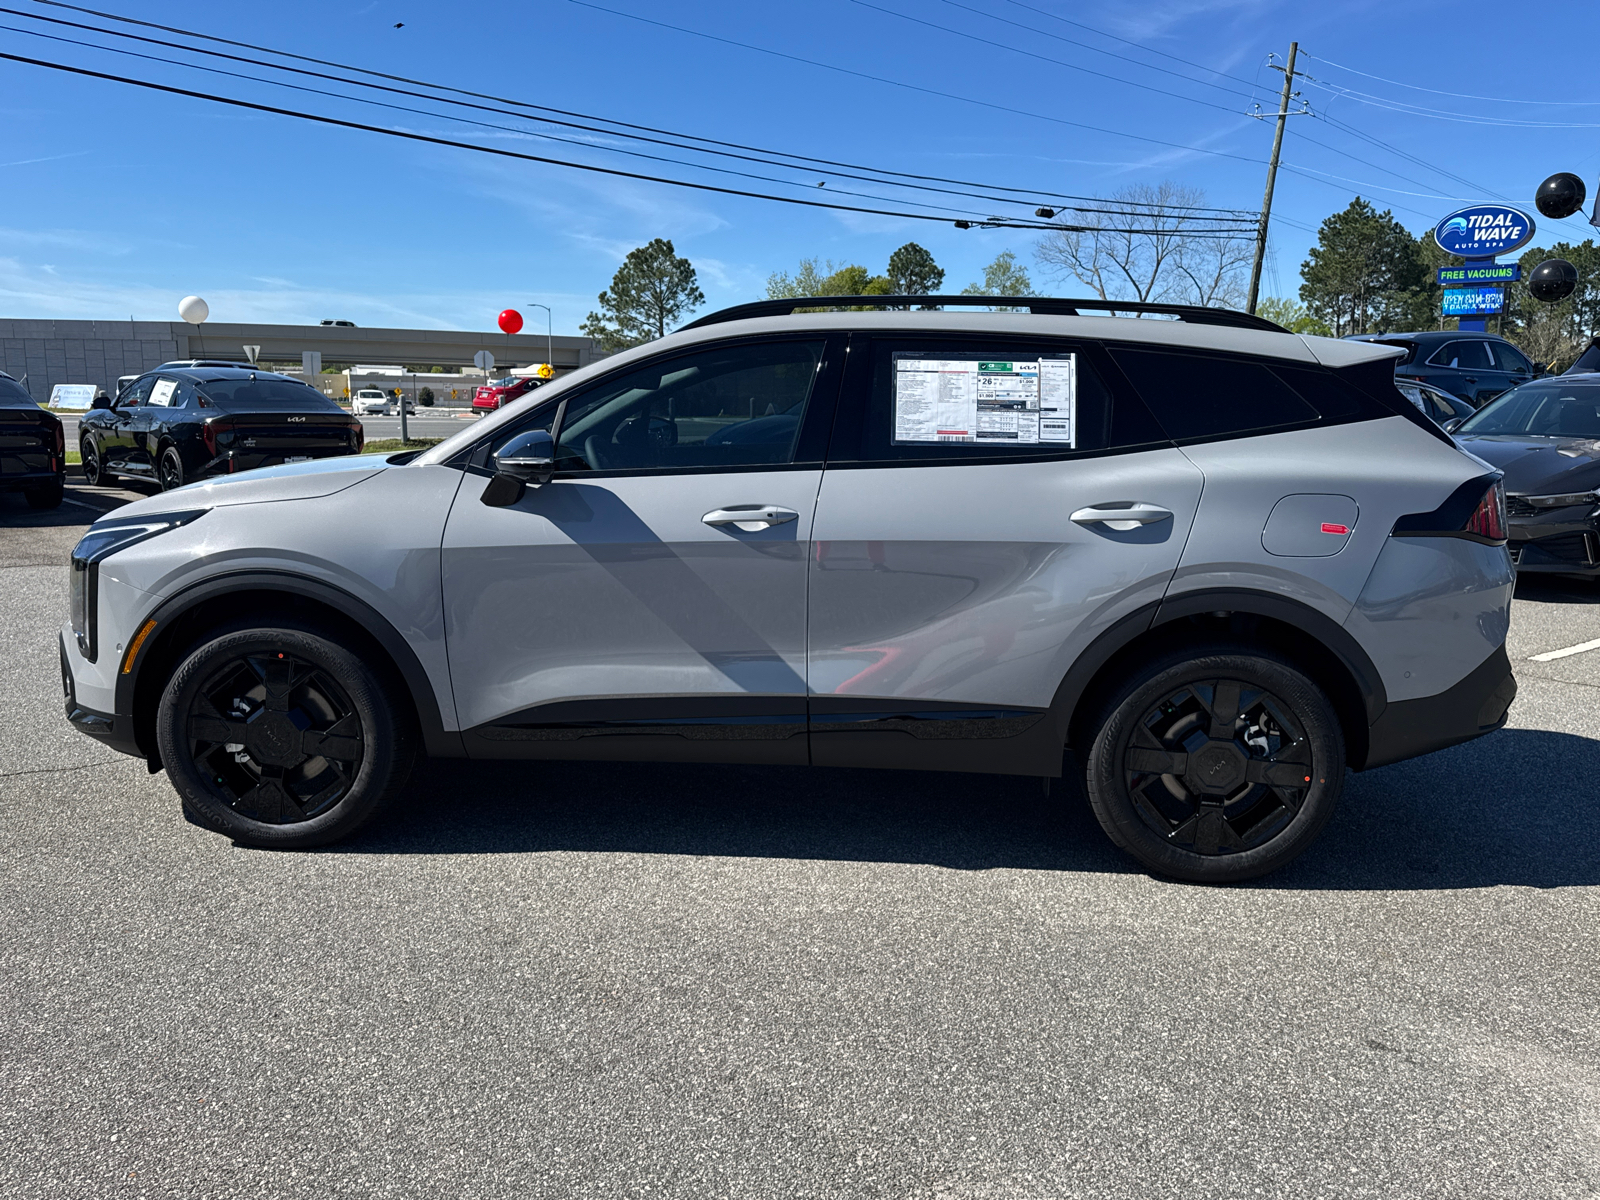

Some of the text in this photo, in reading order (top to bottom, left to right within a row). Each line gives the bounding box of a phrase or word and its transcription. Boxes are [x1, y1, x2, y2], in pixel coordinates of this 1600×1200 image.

[1468, 213, 1513, 228] TIDAL
[1474, 226, 1522, 241] WAVE
[1441, 268, 1513, 280] FREE VACUUMS
[982, 377, 992, 385] 26
[218, 632, 281, 651] CRUGEN
[185, 787, 233, 830] KUMHO
